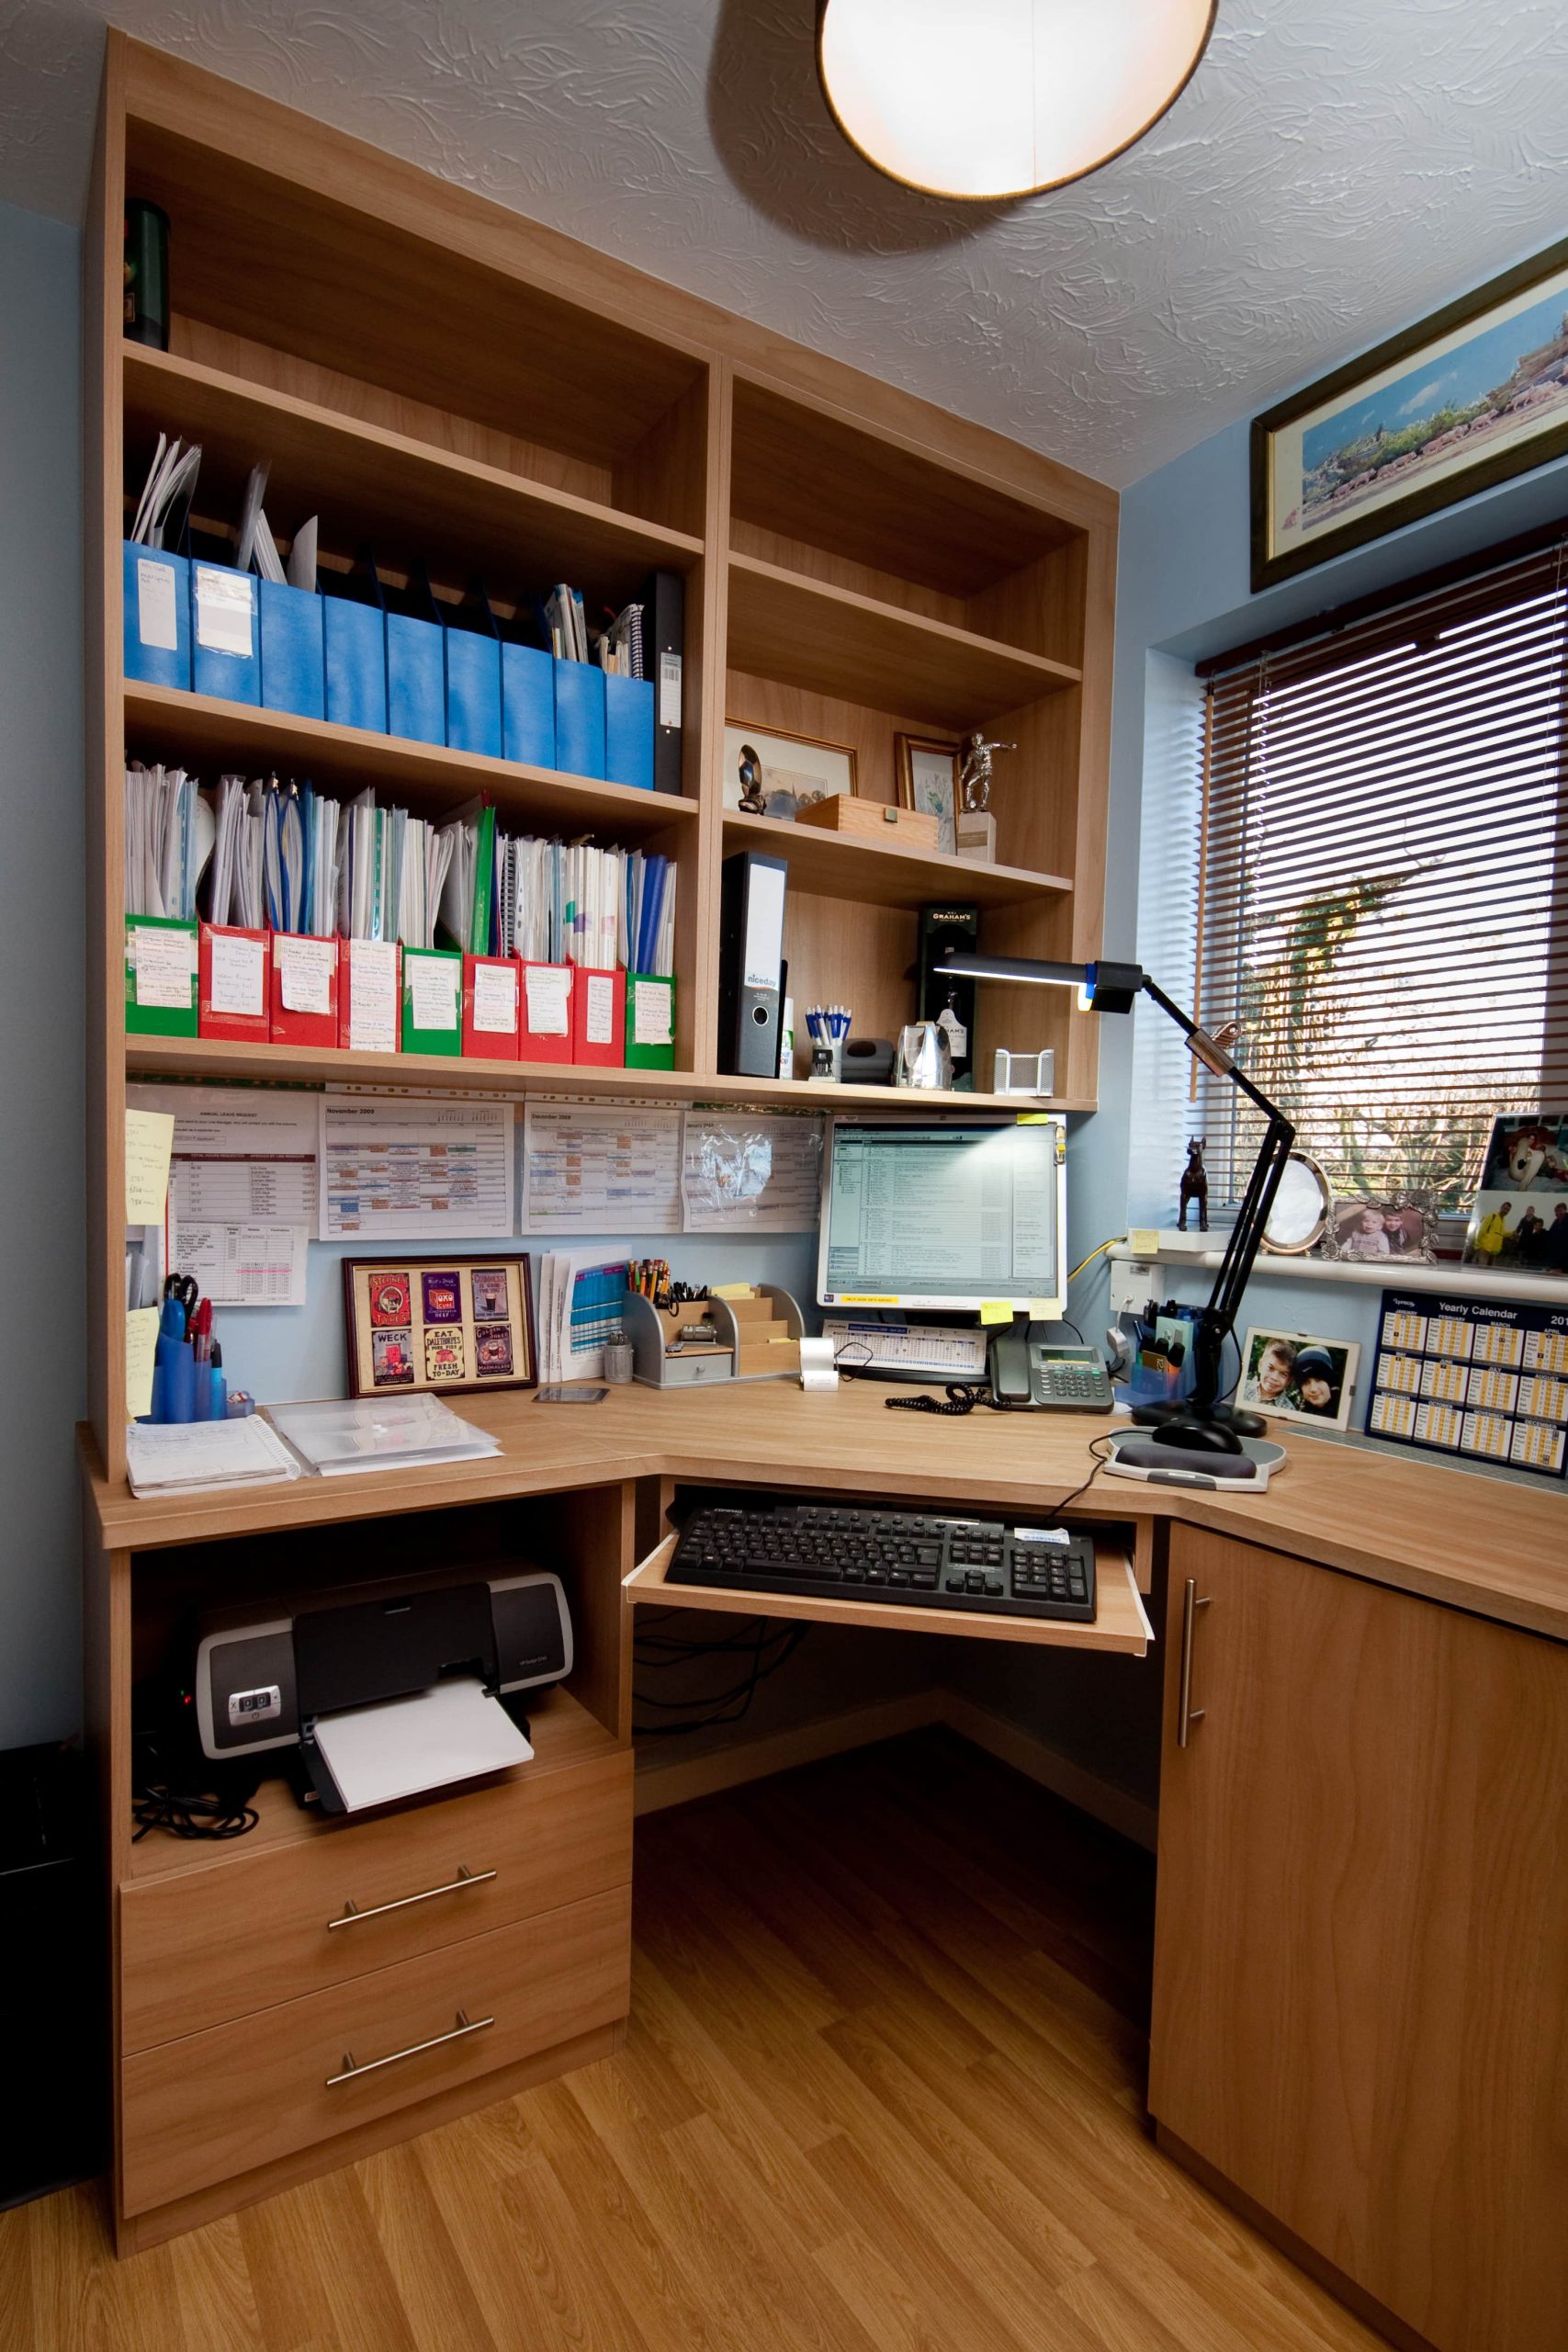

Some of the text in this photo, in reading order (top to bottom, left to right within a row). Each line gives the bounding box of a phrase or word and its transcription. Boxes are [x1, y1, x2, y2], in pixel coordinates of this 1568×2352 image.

[748, 974, 776, 988] niceday
[474, 1274, 504, 1283] GUINNESS
[438, 1295, 453, 1303] OXO
[1439, 1302, 1469, 1315] Yearly
[1472, 1306, 1518, 1319] Calendar
[378, 1333, 407, 1342] WECK
[432, 1369, 459, 1377] TO-DAY
[1473, 1409, 1505, 1419] NOVEMBER
[1525, 1419, 1557, 1430] DECEMBER
